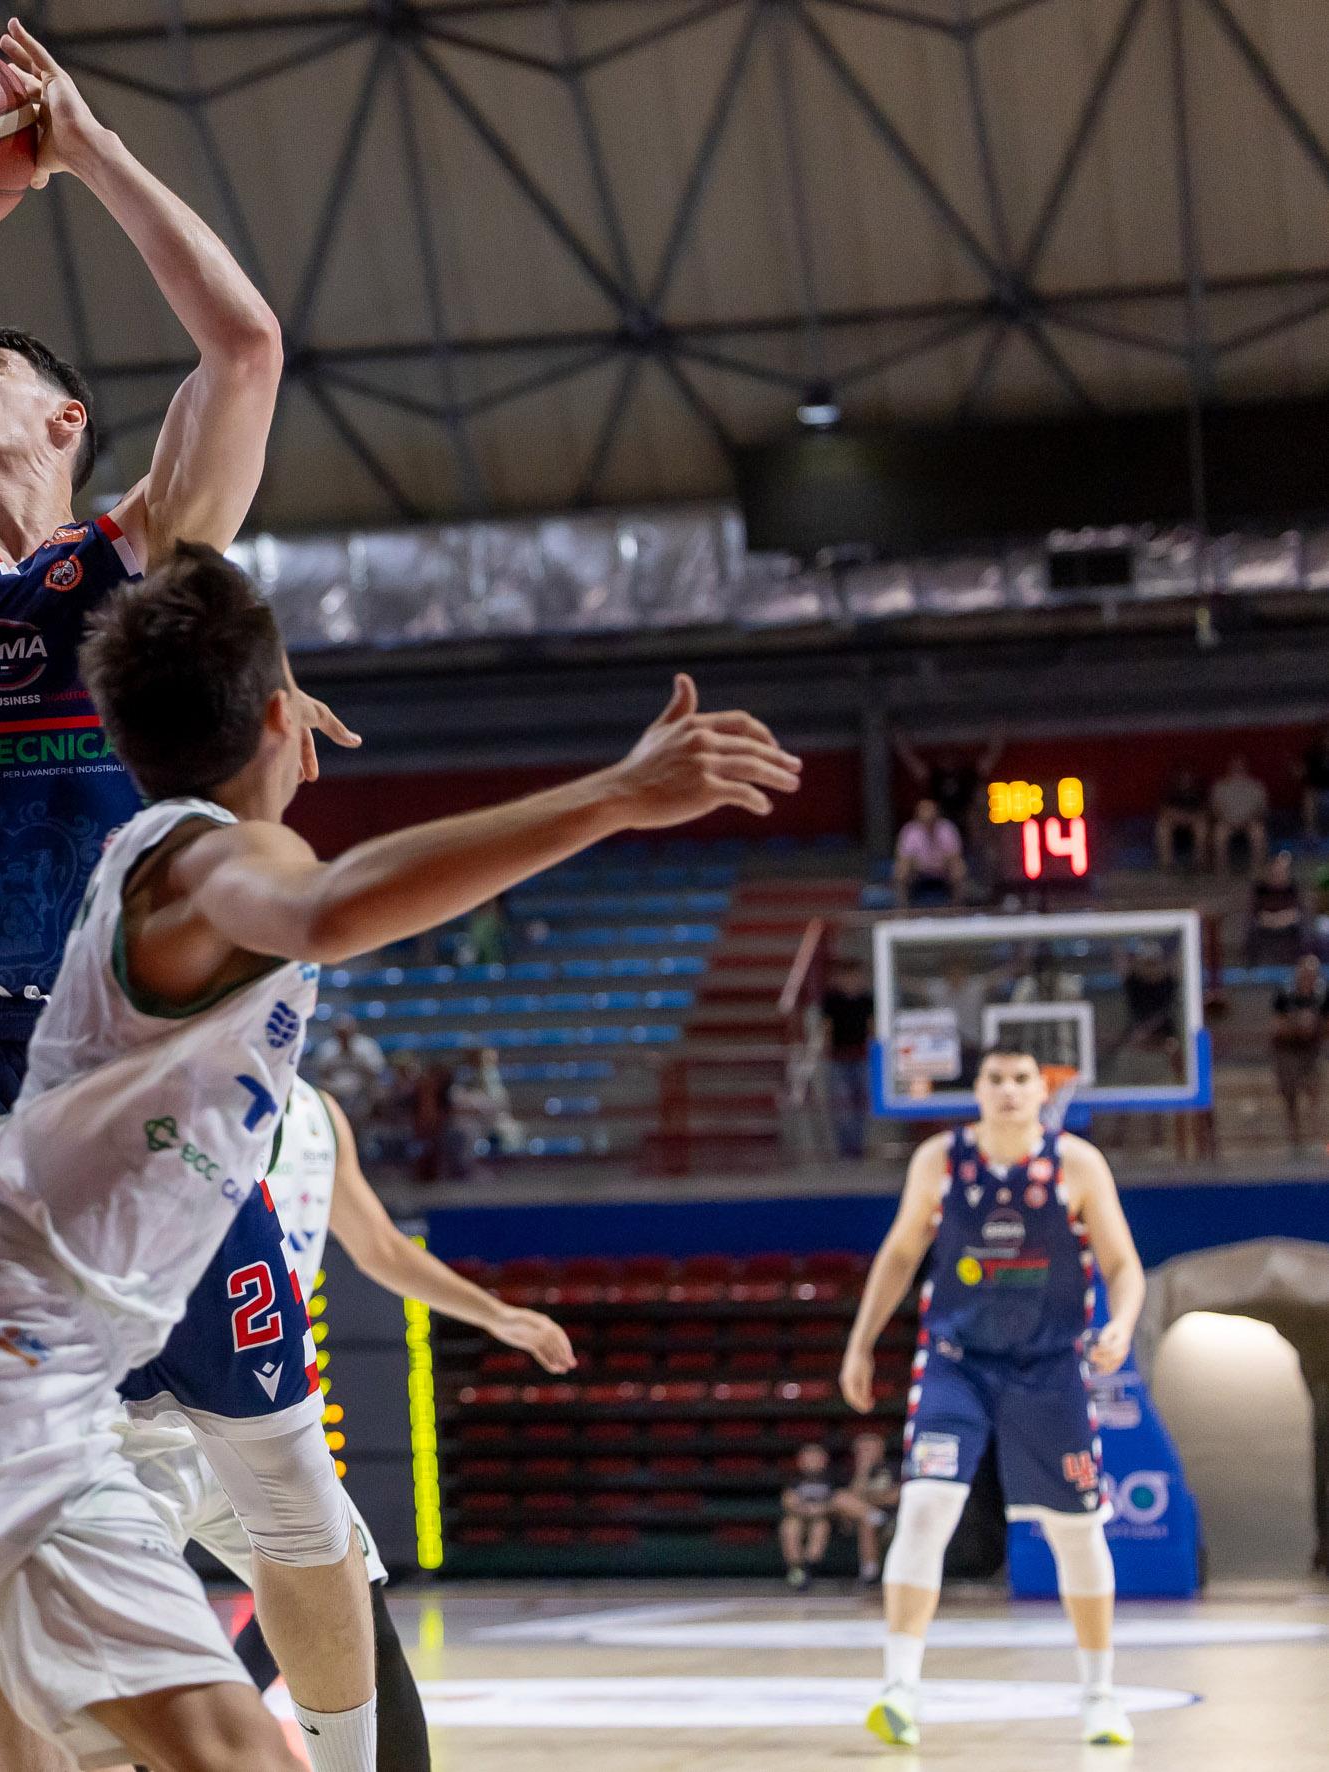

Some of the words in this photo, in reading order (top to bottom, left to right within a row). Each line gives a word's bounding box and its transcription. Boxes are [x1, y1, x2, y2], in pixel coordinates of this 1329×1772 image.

[3, 770, 20, 779] PER
[21, 766, 74, 778] LAVANDERIE
[76, 763, 125, 774] INDUSTRIALI
[1022, 815, 1088, 880] 14
[227, 1260, 283, 1353] 2
